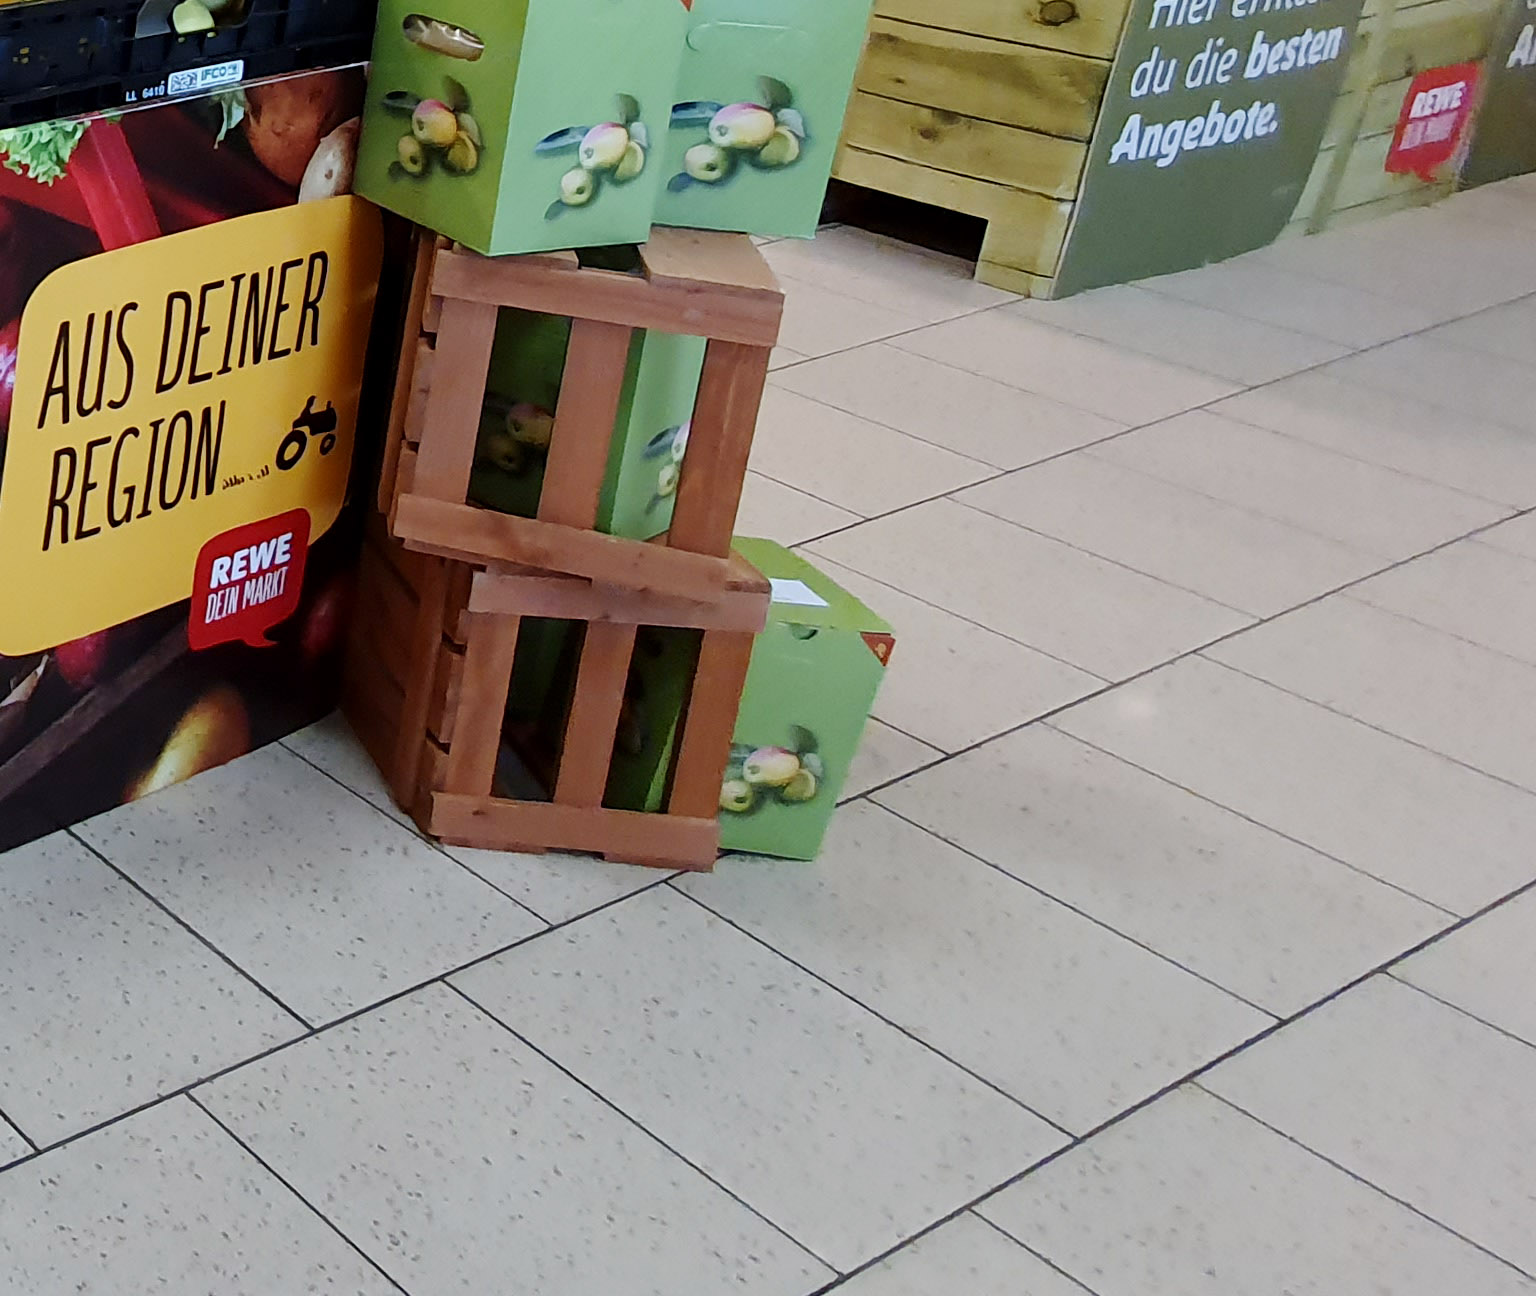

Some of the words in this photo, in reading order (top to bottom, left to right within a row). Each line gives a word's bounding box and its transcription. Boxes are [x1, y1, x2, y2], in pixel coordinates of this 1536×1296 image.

[201, 67, 227, 81] IFCO
[1130, 45, 1178, 99] du
[1185, 37, 1238, 90] die
[1244, 25, 1345, 79] besten
[1109, 98, 1278, 168] Angebote.
[37, 302, 138, 430] AUS
[155, 250, 329, 394] DEINER
[42, 400, 226, 551] REGION
[206, 582, 237, 624] DEIN
[243, 566, 289, 616] MARKT
[210, 532, 292, 589] REWE
